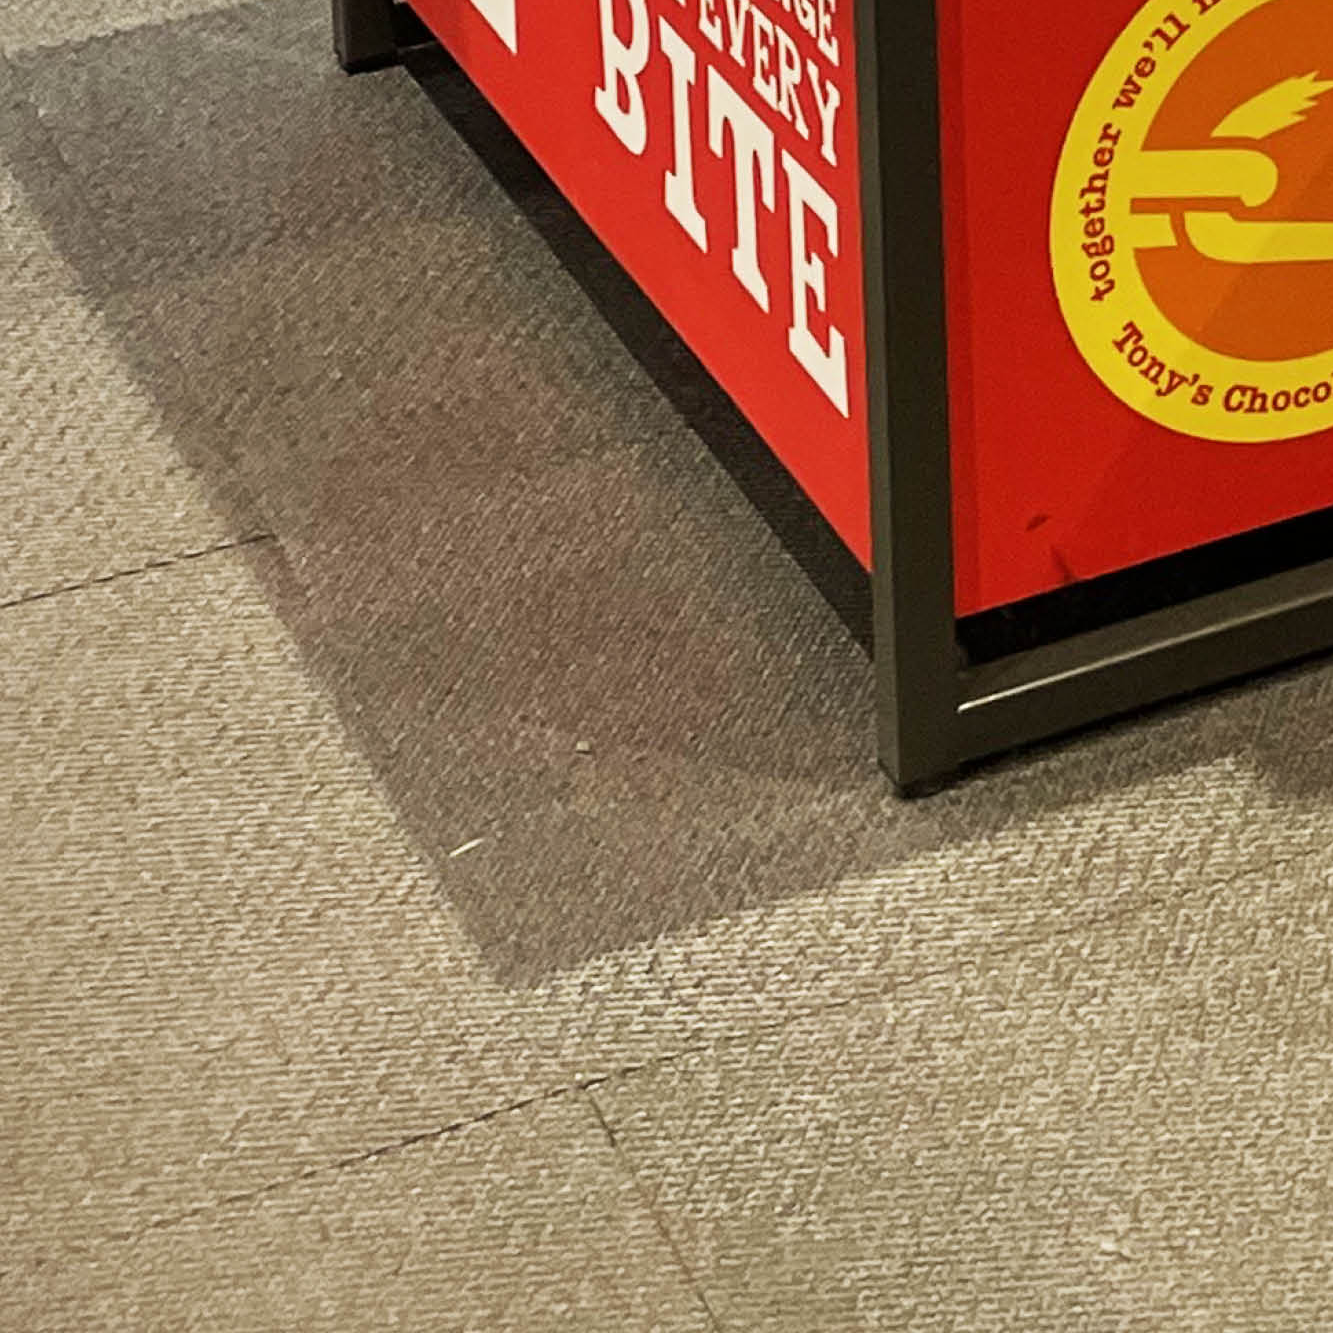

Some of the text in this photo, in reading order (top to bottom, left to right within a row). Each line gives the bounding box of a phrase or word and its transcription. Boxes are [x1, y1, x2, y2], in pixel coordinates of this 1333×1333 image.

[1078, 122, 1122, 302] together
[1112, 12, 1191, 110] we'll
[1112, 321, 1214, 406] Tony's
